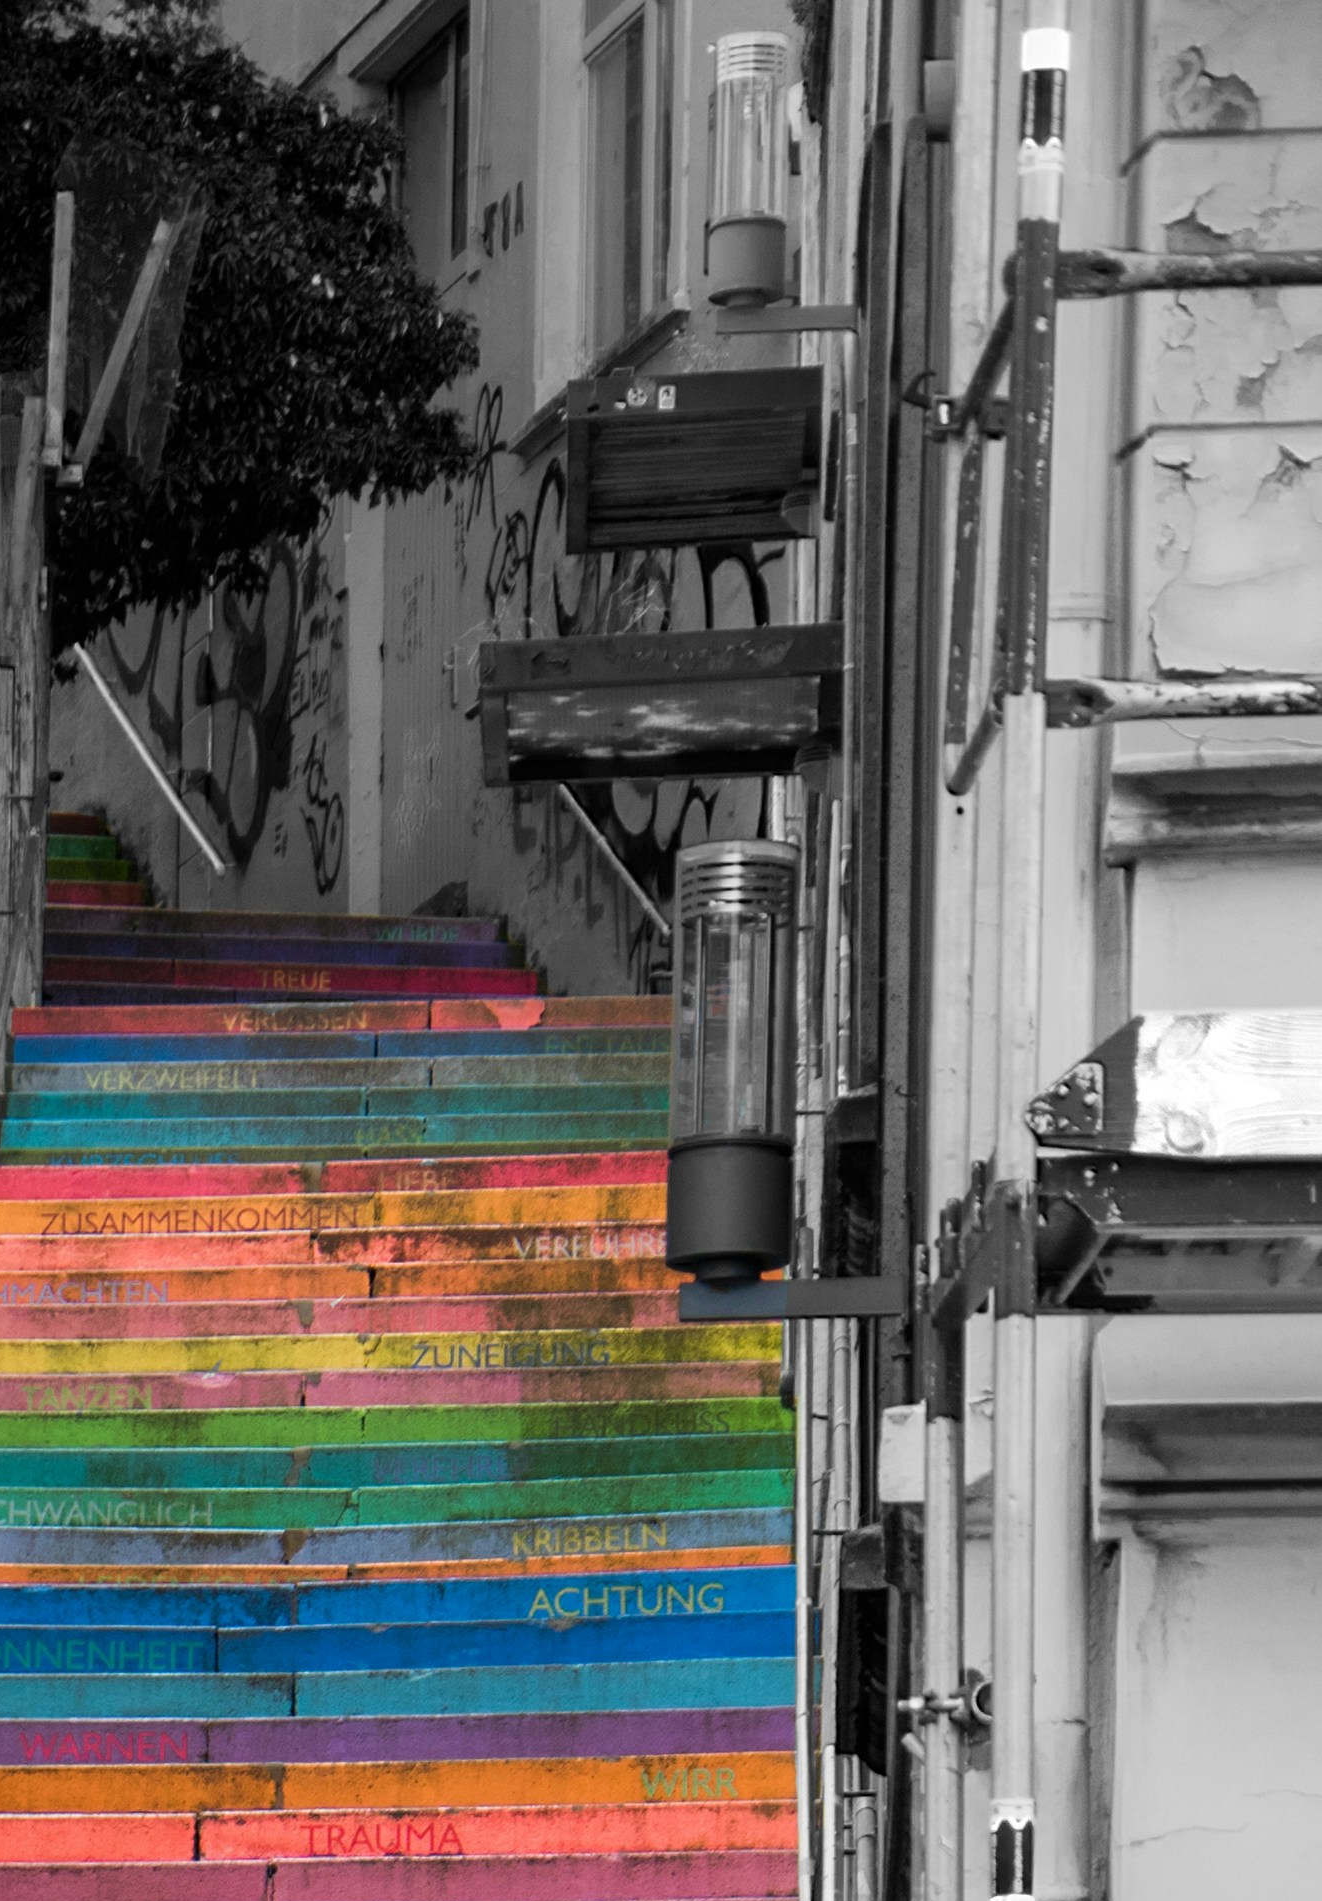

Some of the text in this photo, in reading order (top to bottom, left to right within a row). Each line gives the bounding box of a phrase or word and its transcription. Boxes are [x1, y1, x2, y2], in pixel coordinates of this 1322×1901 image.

[261, 970, 332, 992] TREUE
[85, 1064, 259, 1091] VERZWEIFELT
[41, 1206, 357, 1235] ZUSAMMENKOMMEN
[411, 1341, 610, 1369] ZUNEIGUNG
[23, 1383, 153, 1411] TANZEN
[512, 1523, 668, 1556] KRIBBELN
[528, 1582, 724, 1618] ACHTUNG
[19, 1731, 189, 1762] WARNEN
[642, 1767, 739, 1799] WIRR
[300, 1823, 463, 1855] TRAUMA
